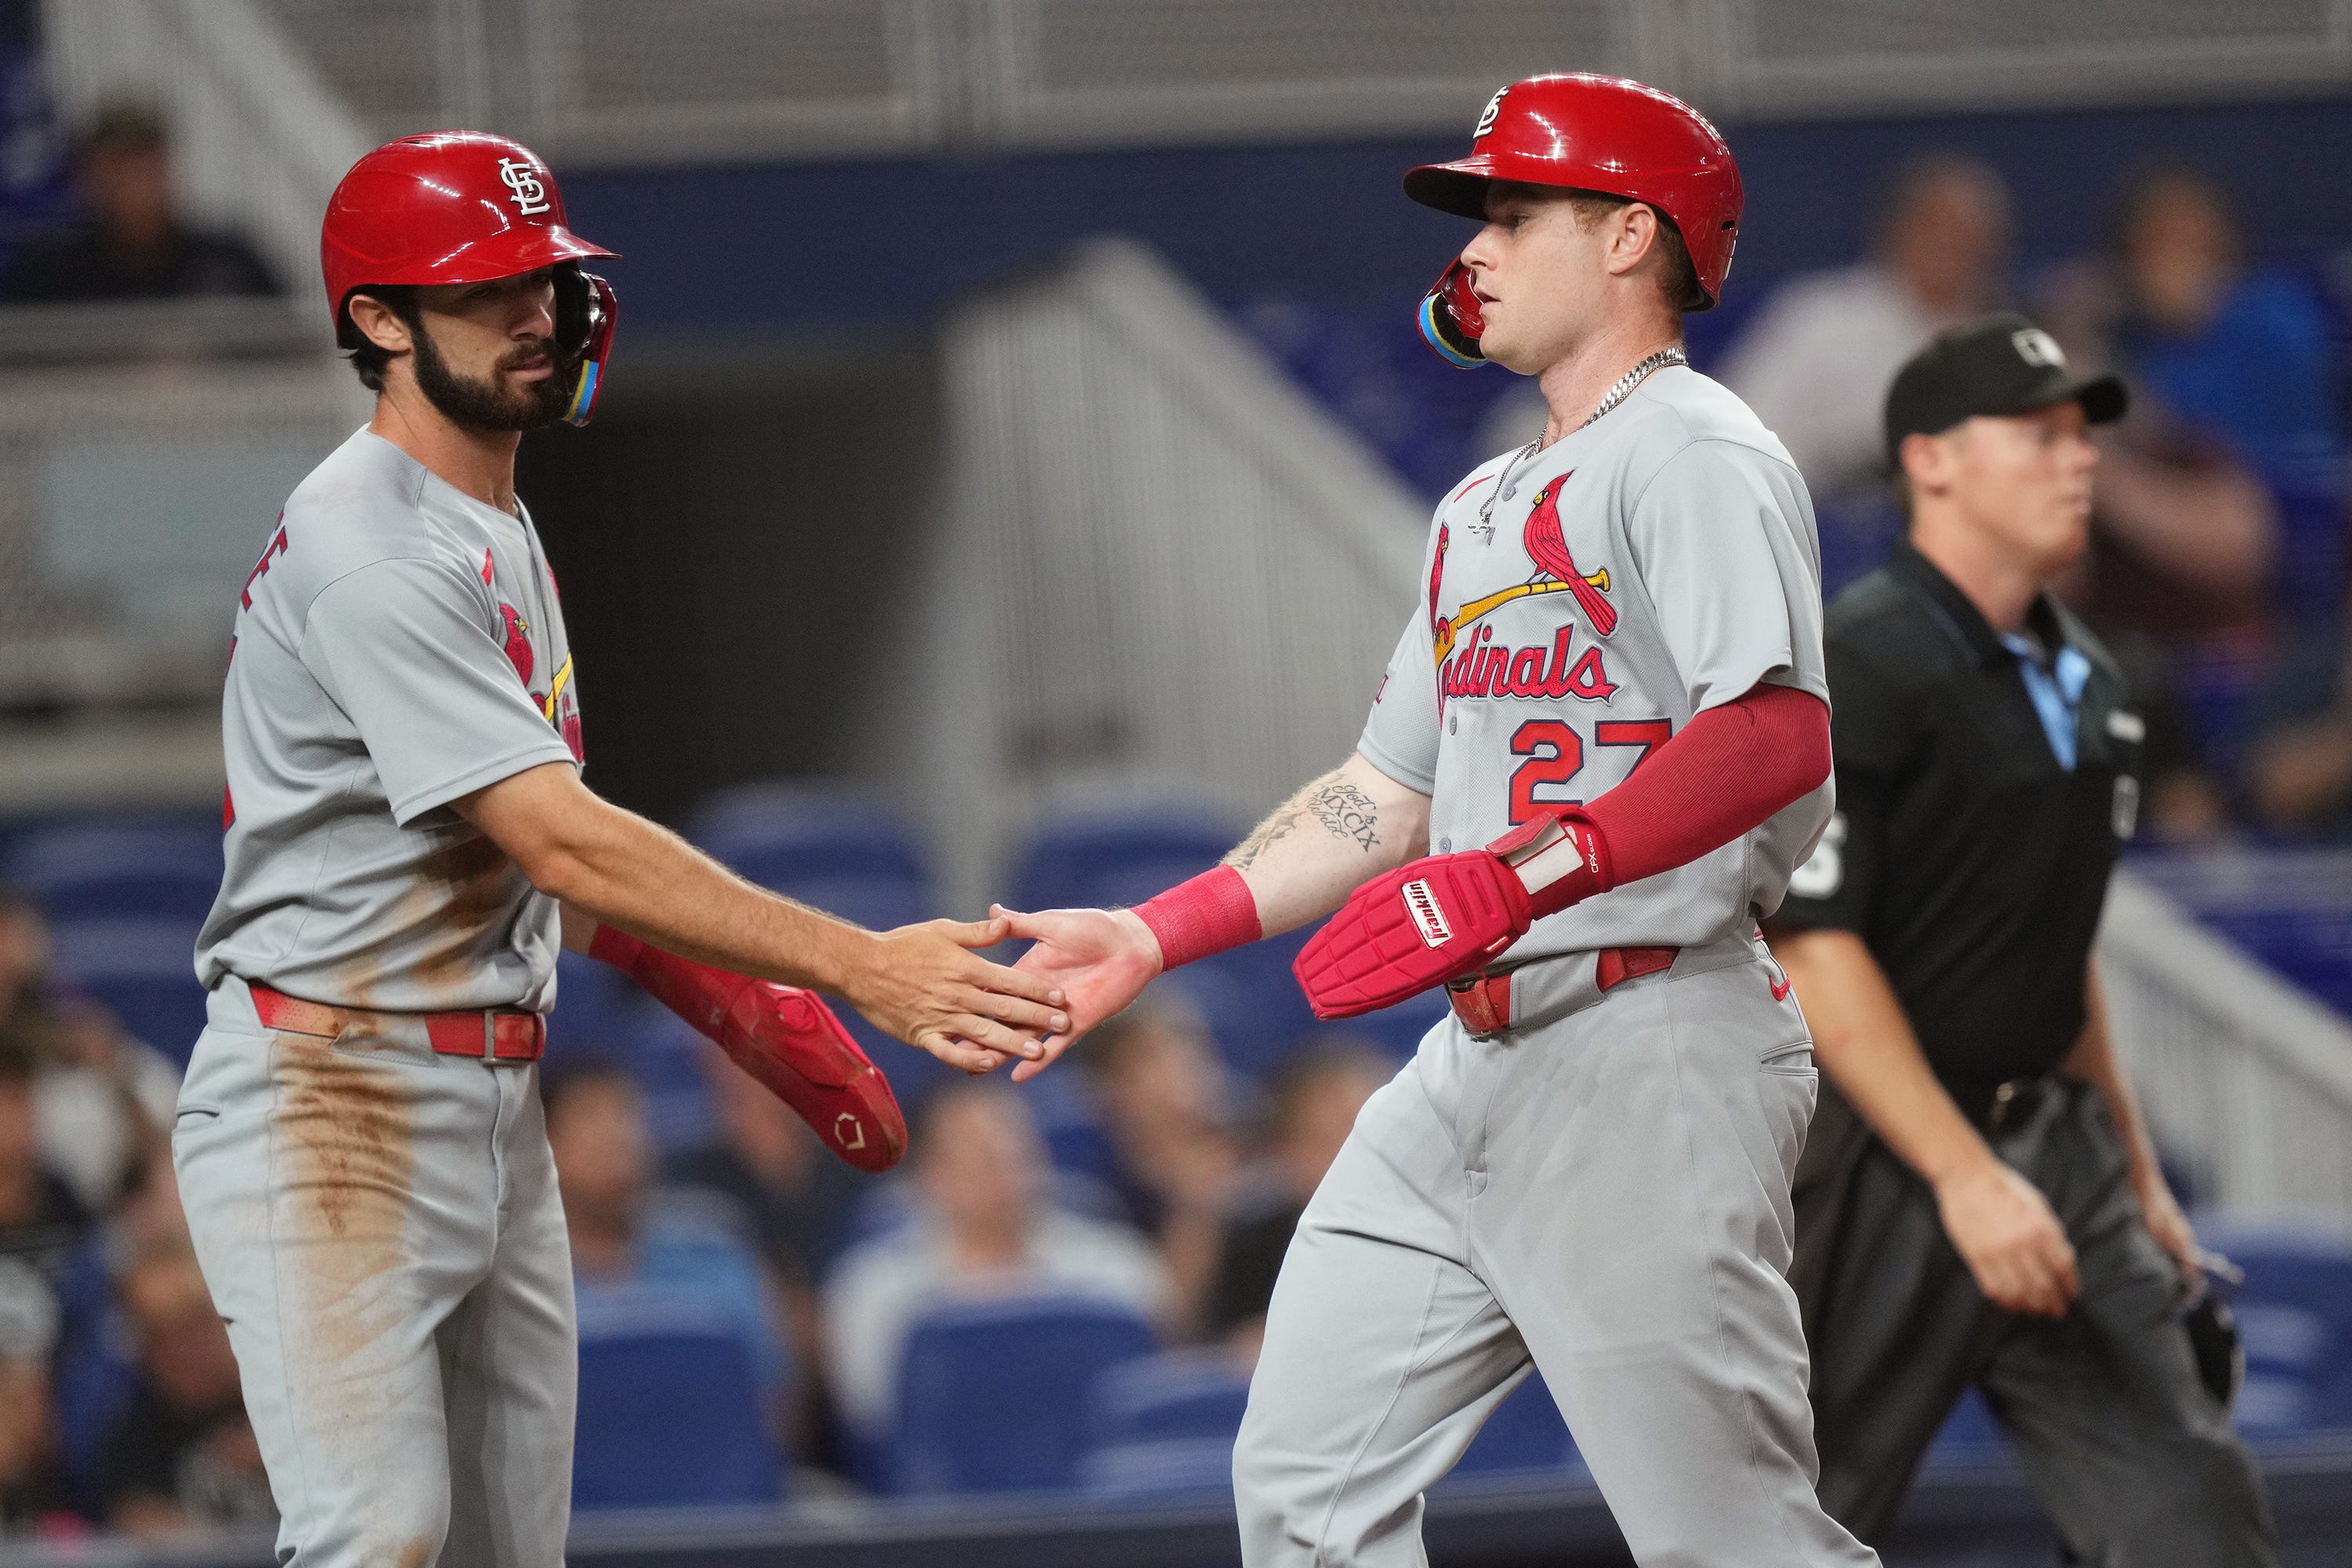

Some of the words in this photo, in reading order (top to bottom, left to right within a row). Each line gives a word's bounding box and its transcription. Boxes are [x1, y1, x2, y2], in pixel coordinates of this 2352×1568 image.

[1508, 718, 1673, 826] 27
[1588, 852, 1599, 873] CFX
[1409, 883, 1450, 940] Franklin
